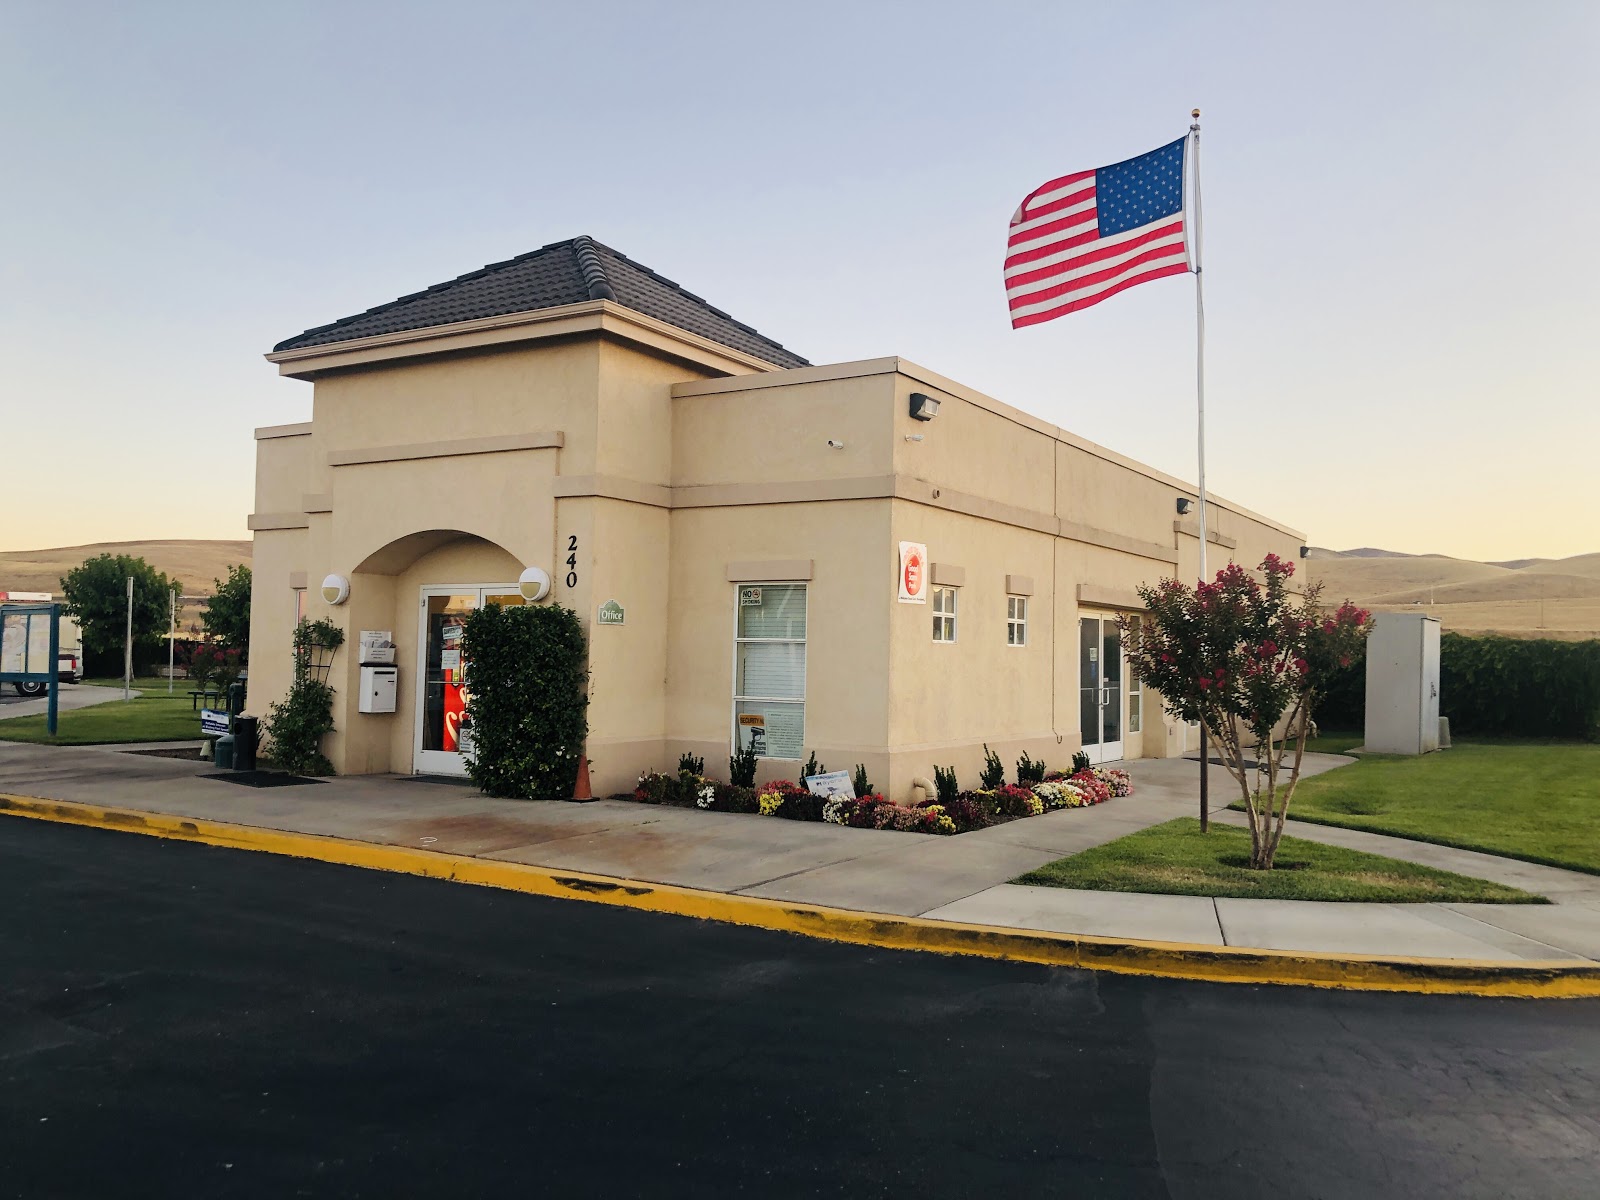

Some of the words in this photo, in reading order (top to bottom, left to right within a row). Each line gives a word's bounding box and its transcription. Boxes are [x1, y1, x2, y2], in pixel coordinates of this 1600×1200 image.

[566, 535, 578, 588] 240
[742, 590, 751, 598] NO
[601, 610, 623, 620] Office
